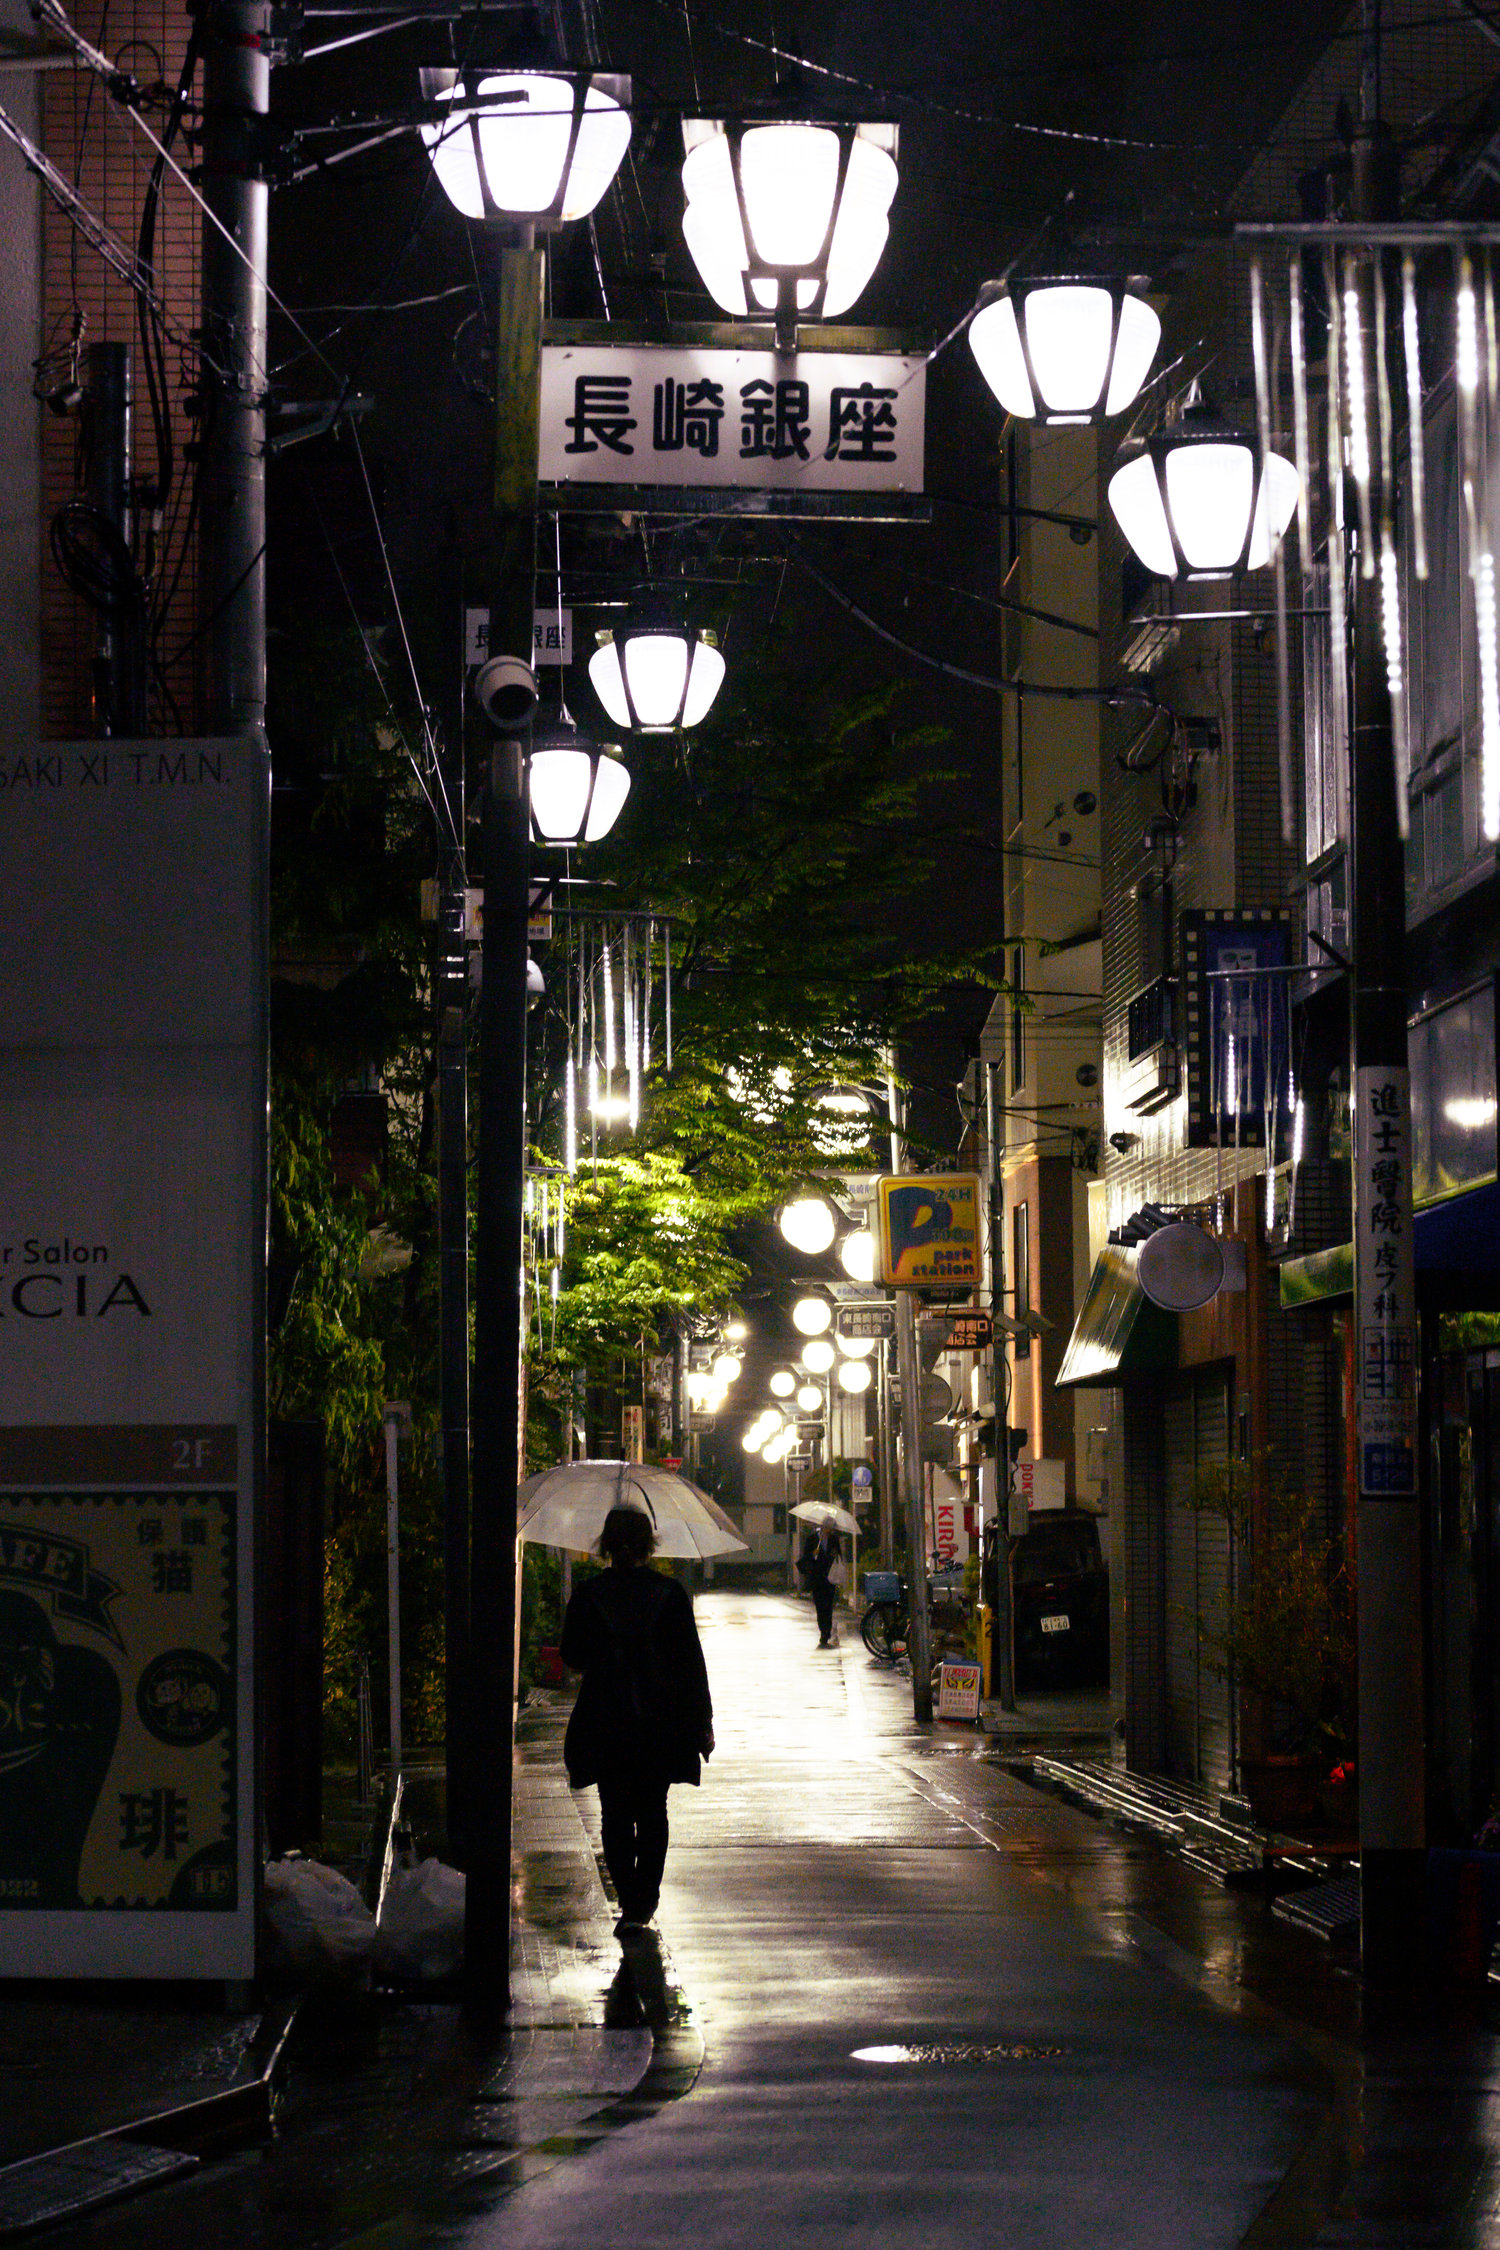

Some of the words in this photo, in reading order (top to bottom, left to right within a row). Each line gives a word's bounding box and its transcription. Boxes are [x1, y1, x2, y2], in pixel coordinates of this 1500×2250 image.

[564, 376, 898, 462] 長崎銀座
[80, 755, 108, 786] XI
[24, 1238, 108, 1264] Salon
[934, 1248, 973, 1264] park
[912, 1262, 975, 1276] station
[0, 1275, 153, 1318] CIA
[172, 1439, 213, 1468] 2F
[119, 1788, 189, 1861] 琲
